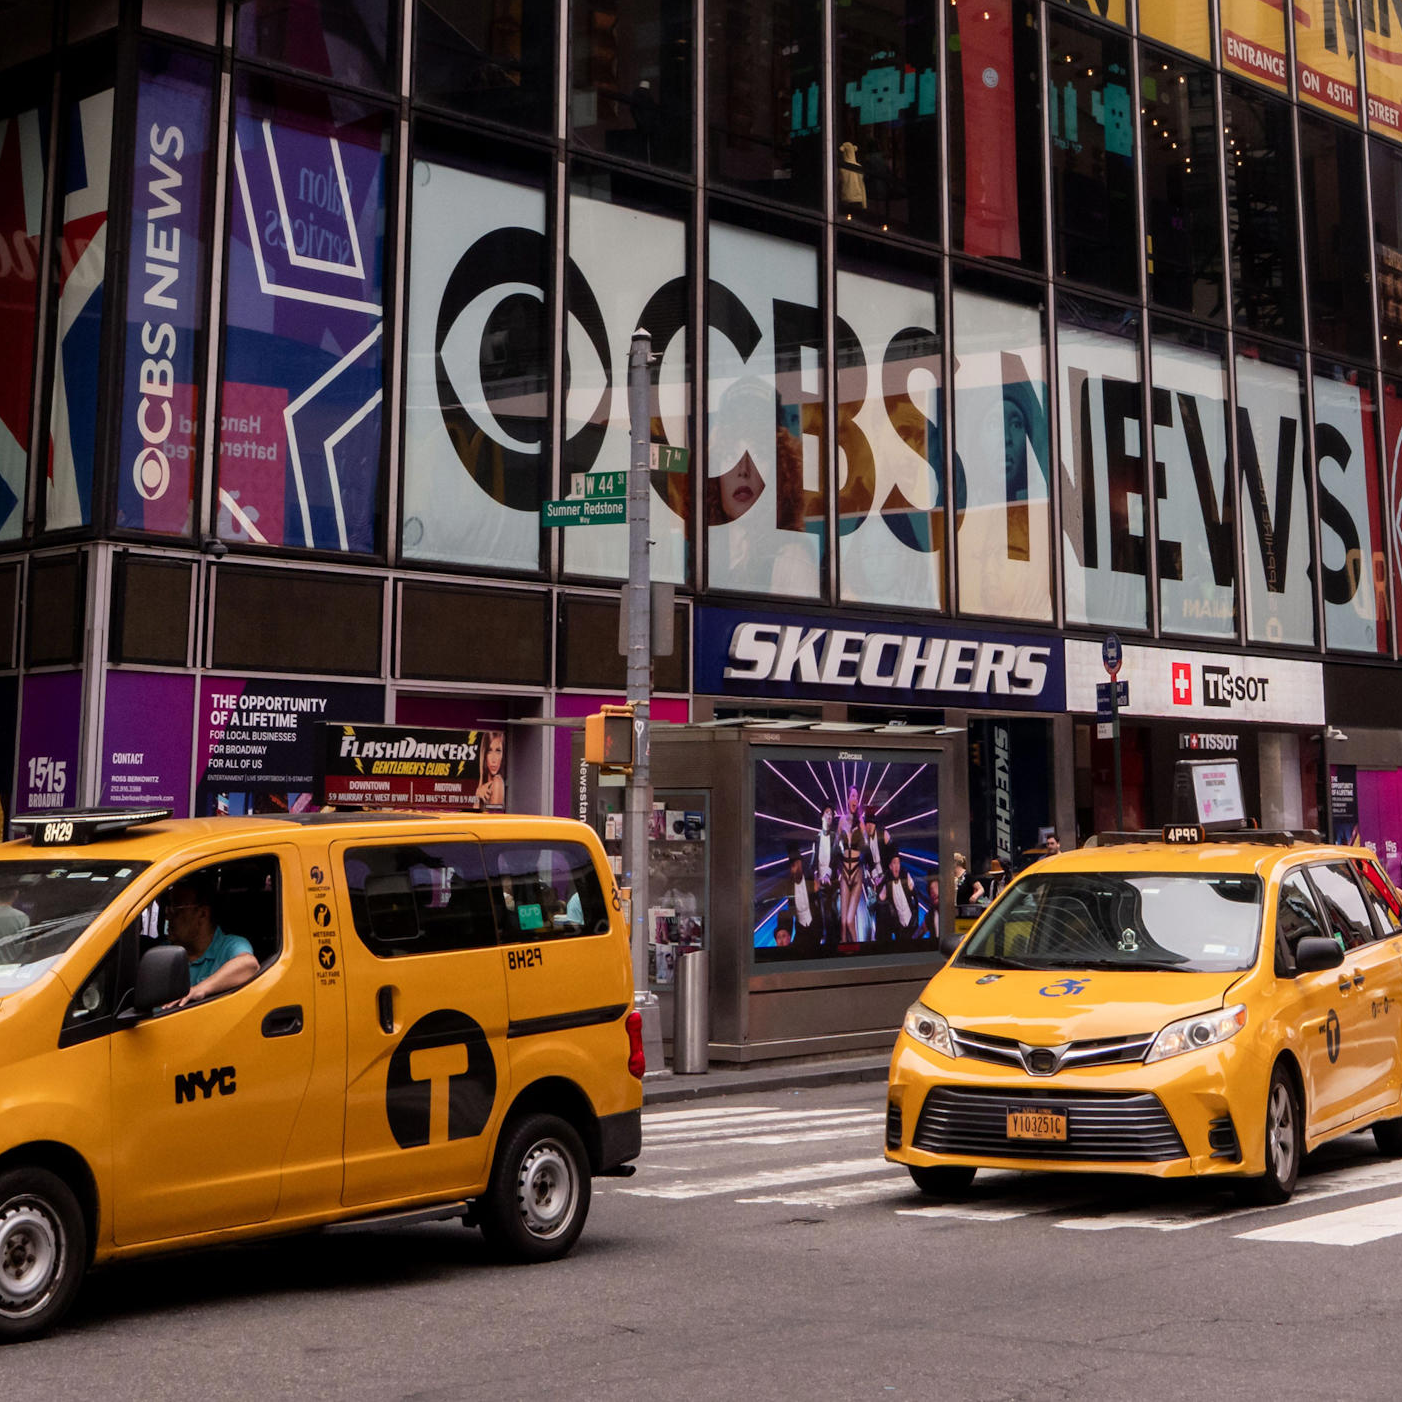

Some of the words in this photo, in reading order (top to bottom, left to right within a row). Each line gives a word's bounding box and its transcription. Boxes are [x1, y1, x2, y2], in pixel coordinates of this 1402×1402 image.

[1226, 38, 1286, 79] ENTRANCE
[1302, 69, 1320, 93] ON
[1326, 79, 1354, 108] 45TH
[1368, 98, 1399, 127] STREET
[143, 122, 185, 311] NEWS
[137, 318, 177, 445] CBS
[627, 273, 964, 556] CBS
[1000, 350, 1363, 605] NEWS
[666, 449, 672, 468] 7
[586, 476, 596, 495] W
[598, 475, 614, 493] 44
[547, 503, 582, 517] Sumner
[583, 502, 623, 515] Redstone
[723, 621, 1051, 697] SKECHERS
[1205, 672, 1269, 702] TISSOT
[211, 694, 237, 709] THE
[239, 695, 327, 713] OPPORTUNITY
[210, 711, 228, 725] OF
[230, 712, 240, 726] A
[242, 713, 298, 728] LIFETIME
[209, 730, 225, 740] FOR
[226, 731, 250, 741] LOCAL
[252, 732, 297, 742] BUSINESSES
[1199, 734, 1239, 750] TISSOT
[113, 753, 144, 765] CONTACT
[209, 745, 225, 754] FOR
[225, 745, 267, 755] BROADWAY
[208, 759, 224, 768] FOR
[225, 759, 238, 769] ALL
[240, 759, 251, 769] OF
[252, 760, 263, 769] US
[372, 761, 424, 775] GENTLEMEN'S
[425, 762, 451, 776] CLUBS
[349, 781, 390, 790] DOWNTOWN
[434, 783, 461, 792] MIDTOWN
[579, 757, 589, 824] Newsstan
[993, 724, 1016, 866] SKECHE
[28, 793, 65, 807] BROADWAY
[44, 822, 74, 843] 8H29
[1168, 828, 1198, 842] 4P99
[508, 948, 542, 971] 8H29
[175, 1065, 237, 1104] NYC
[1013, 1115, 1061, 1135] Y103251C
